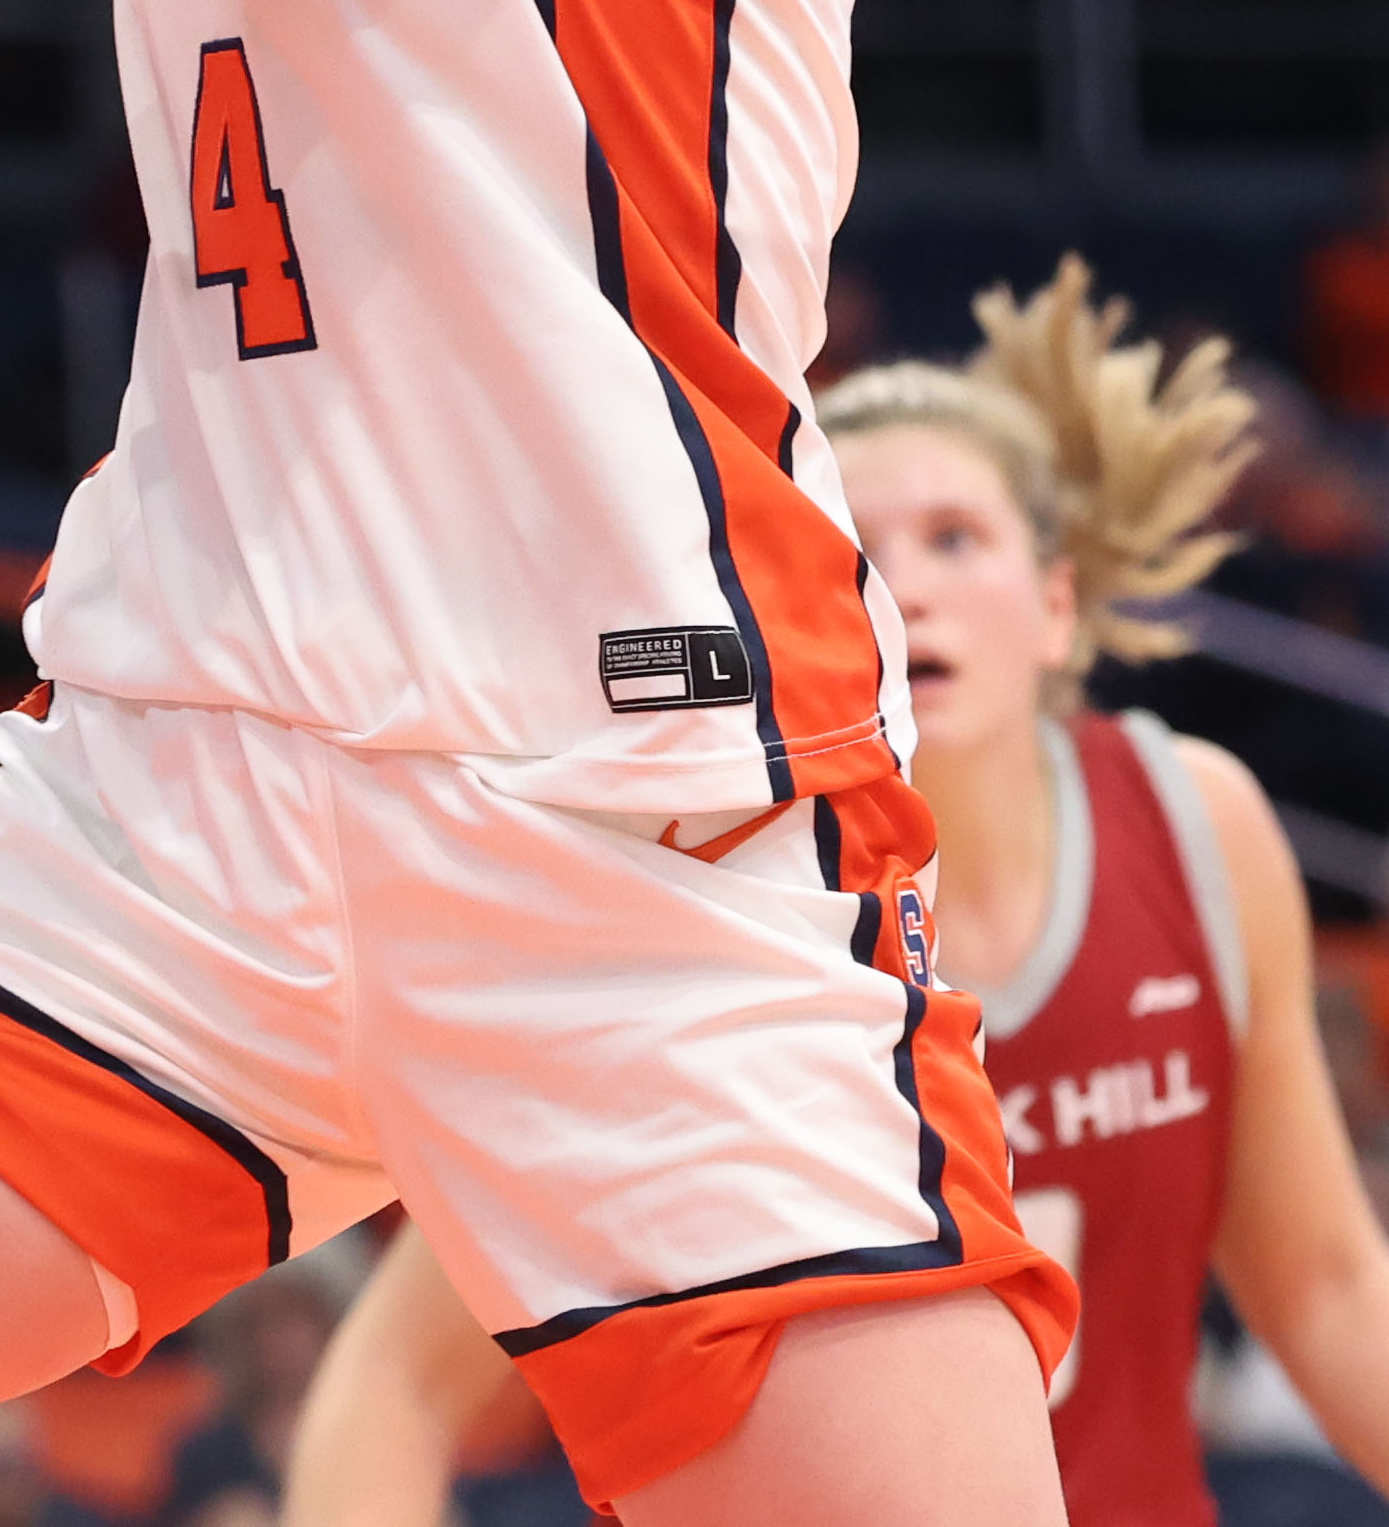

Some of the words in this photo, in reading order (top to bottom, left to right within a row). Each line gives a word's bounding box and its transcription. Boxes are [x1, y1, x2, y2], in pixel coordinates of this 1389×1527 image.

[189, 36, 318, 361] 4
[605, 639, 683, 655] ENGINEERED
[709, 650, 731, 681] L
[1000, 1081, 1043, 1155] K
[1050, 1050, 1210, 1148] HILL
